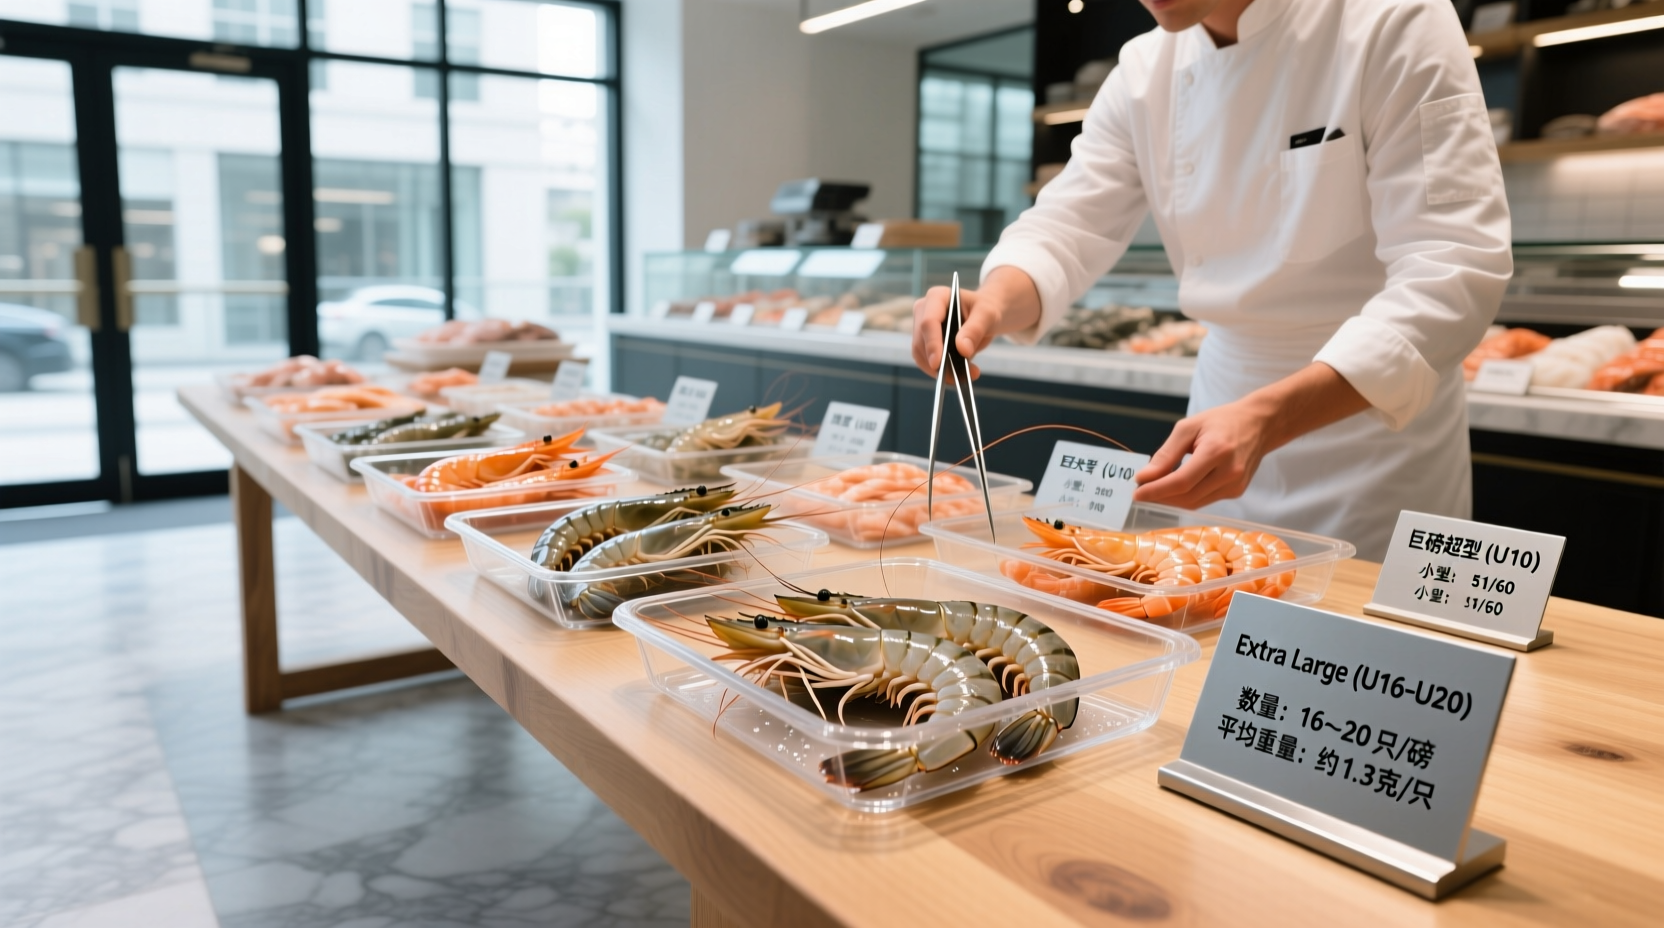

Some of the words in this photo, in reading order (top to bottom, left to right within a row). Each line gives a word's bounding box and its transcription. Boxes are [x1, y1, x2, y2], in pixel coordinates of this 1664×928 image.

[1485, 543, 1541, 574] (U10)
[1471, 574, 1515, 595] 51/60
[1235, 633, 1287, 667] Extra
[1291, 648, 1349, 686] Large
